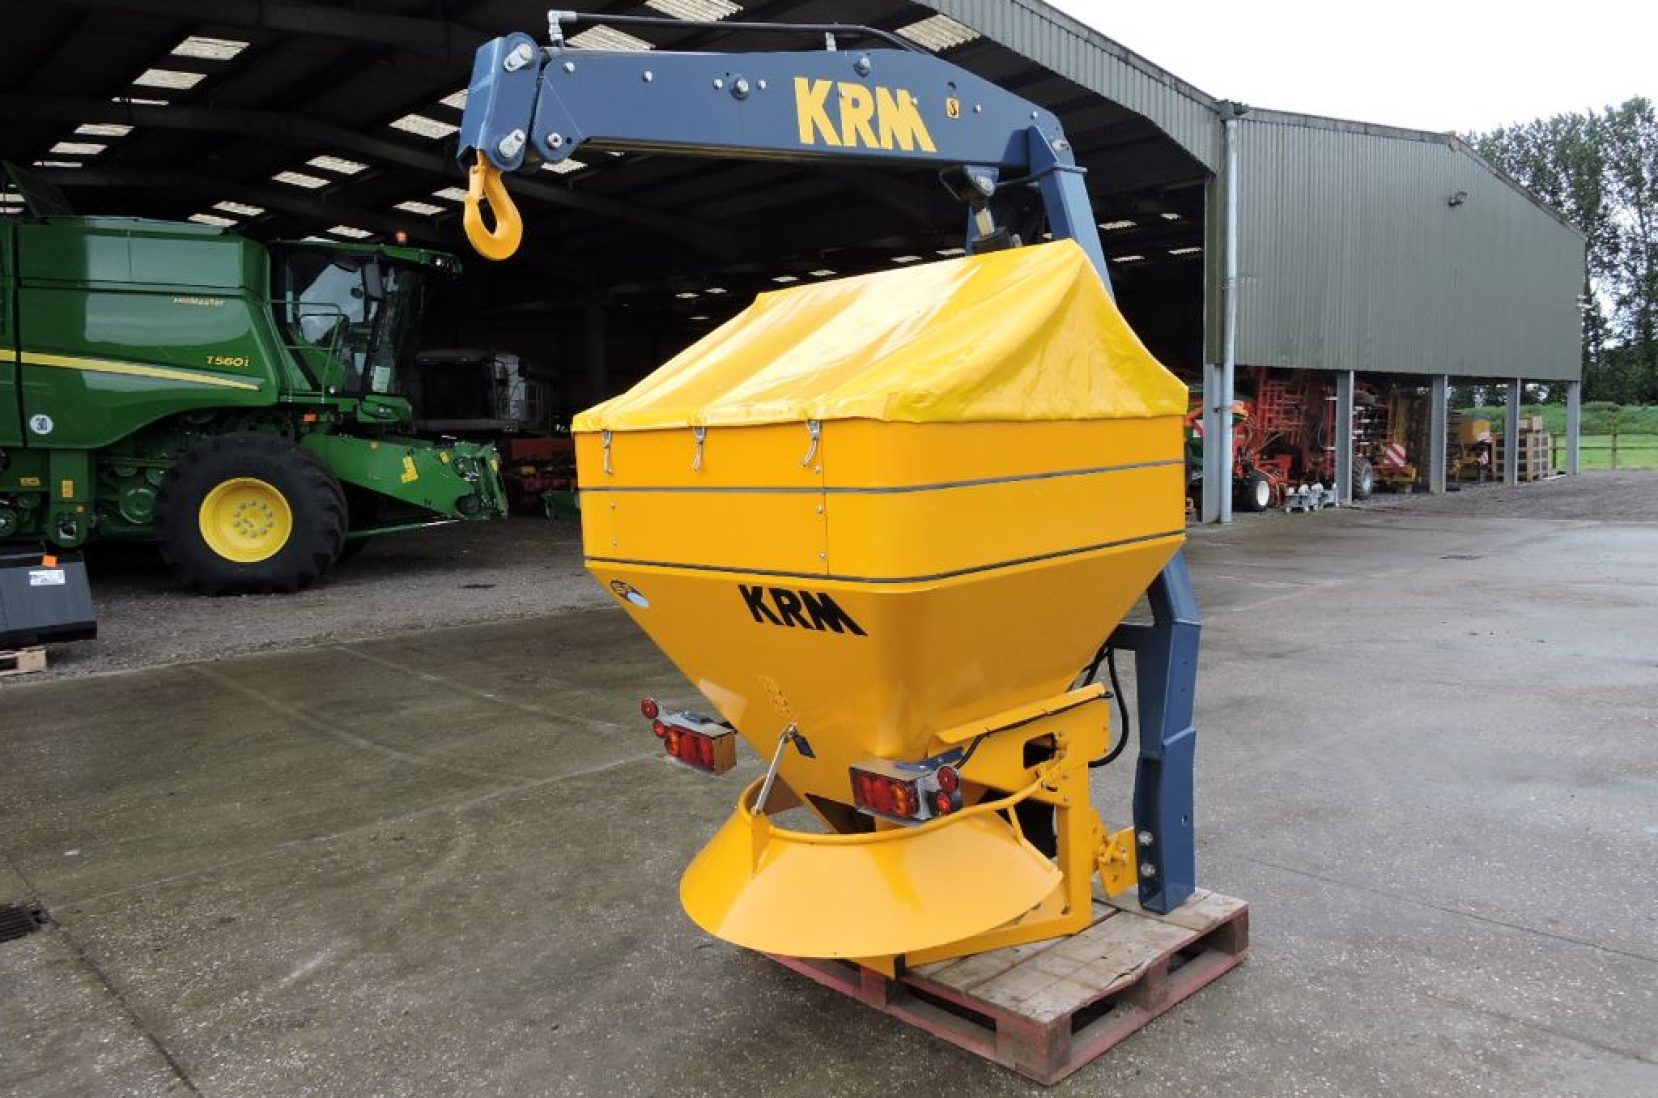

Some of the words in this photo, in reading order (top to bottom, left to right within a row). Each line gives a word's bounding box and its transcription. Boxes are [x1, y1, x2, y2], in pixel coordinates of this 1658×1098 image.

[794, 76, 938, 153] KRM
[206, 355, 249, 367] T560i
[738, 584, 869, 637] KRM
